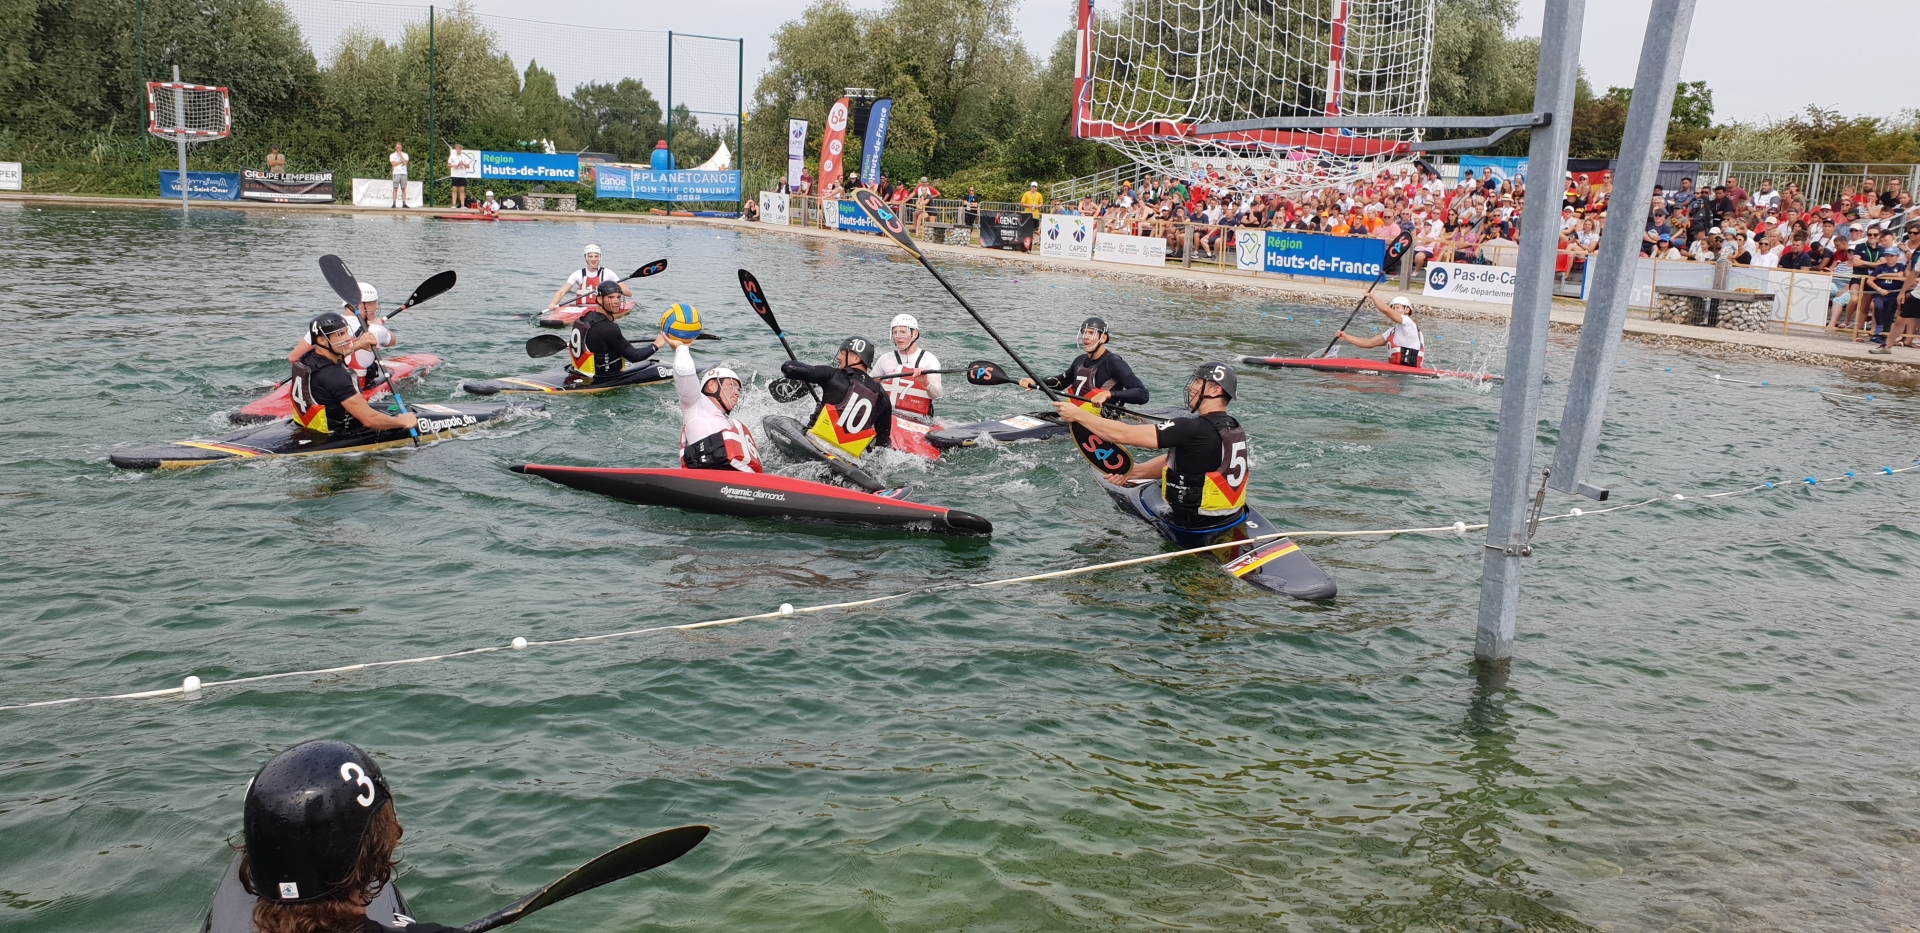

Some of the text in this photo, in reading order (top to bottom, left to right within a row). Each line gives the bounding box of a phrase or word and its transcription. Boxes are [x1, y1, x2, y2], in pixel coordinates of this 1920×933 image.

[831, 109, 845, 124] 62
[484, 154, 514, 164] Région
[244, 170, 332, 181] GROUPE LEMPEREUR
[484, 164, 575, 177] Hauts-de-France
[633, 173, 736, 183] #PLANETCANOE
[194, 185, 228, 193] Saint-Omer
[600, 177, 626, 186] canoe
[840, 214, 878, 228] Hauts-de-Fra
[1044, 243, 1062, 251] CAPSO
[1069, 244, 1088, 253] CAPSO
[1267, 236, 1302, 250] Région
[1390, 236, 1409, 257] CPS
[643, 262, 663, 276] CPS
[1267, 252, 1380, 275] Hauts-de-France
[1431, 272, 1446, 285] 62
[744, 281, 766, 314] CPS
[312, 321, 318, 335] 4
[571, 328, 582, 358] 9
[970, 365, 993, 380] CPS
[899, 379, 914, 400] 7
[1076, 376, 1087, 396] 7
[292, 376, 307, 413] 4
[837, 391, 872, 434] 10
[1081, 435, 1124, 469] CPS
[1226, 441, 1246, 487] 5
[721, 486, 752, 496] dynamic
[753, 489, 784, 501] diamond
[340, 762, 375, 806] 3
